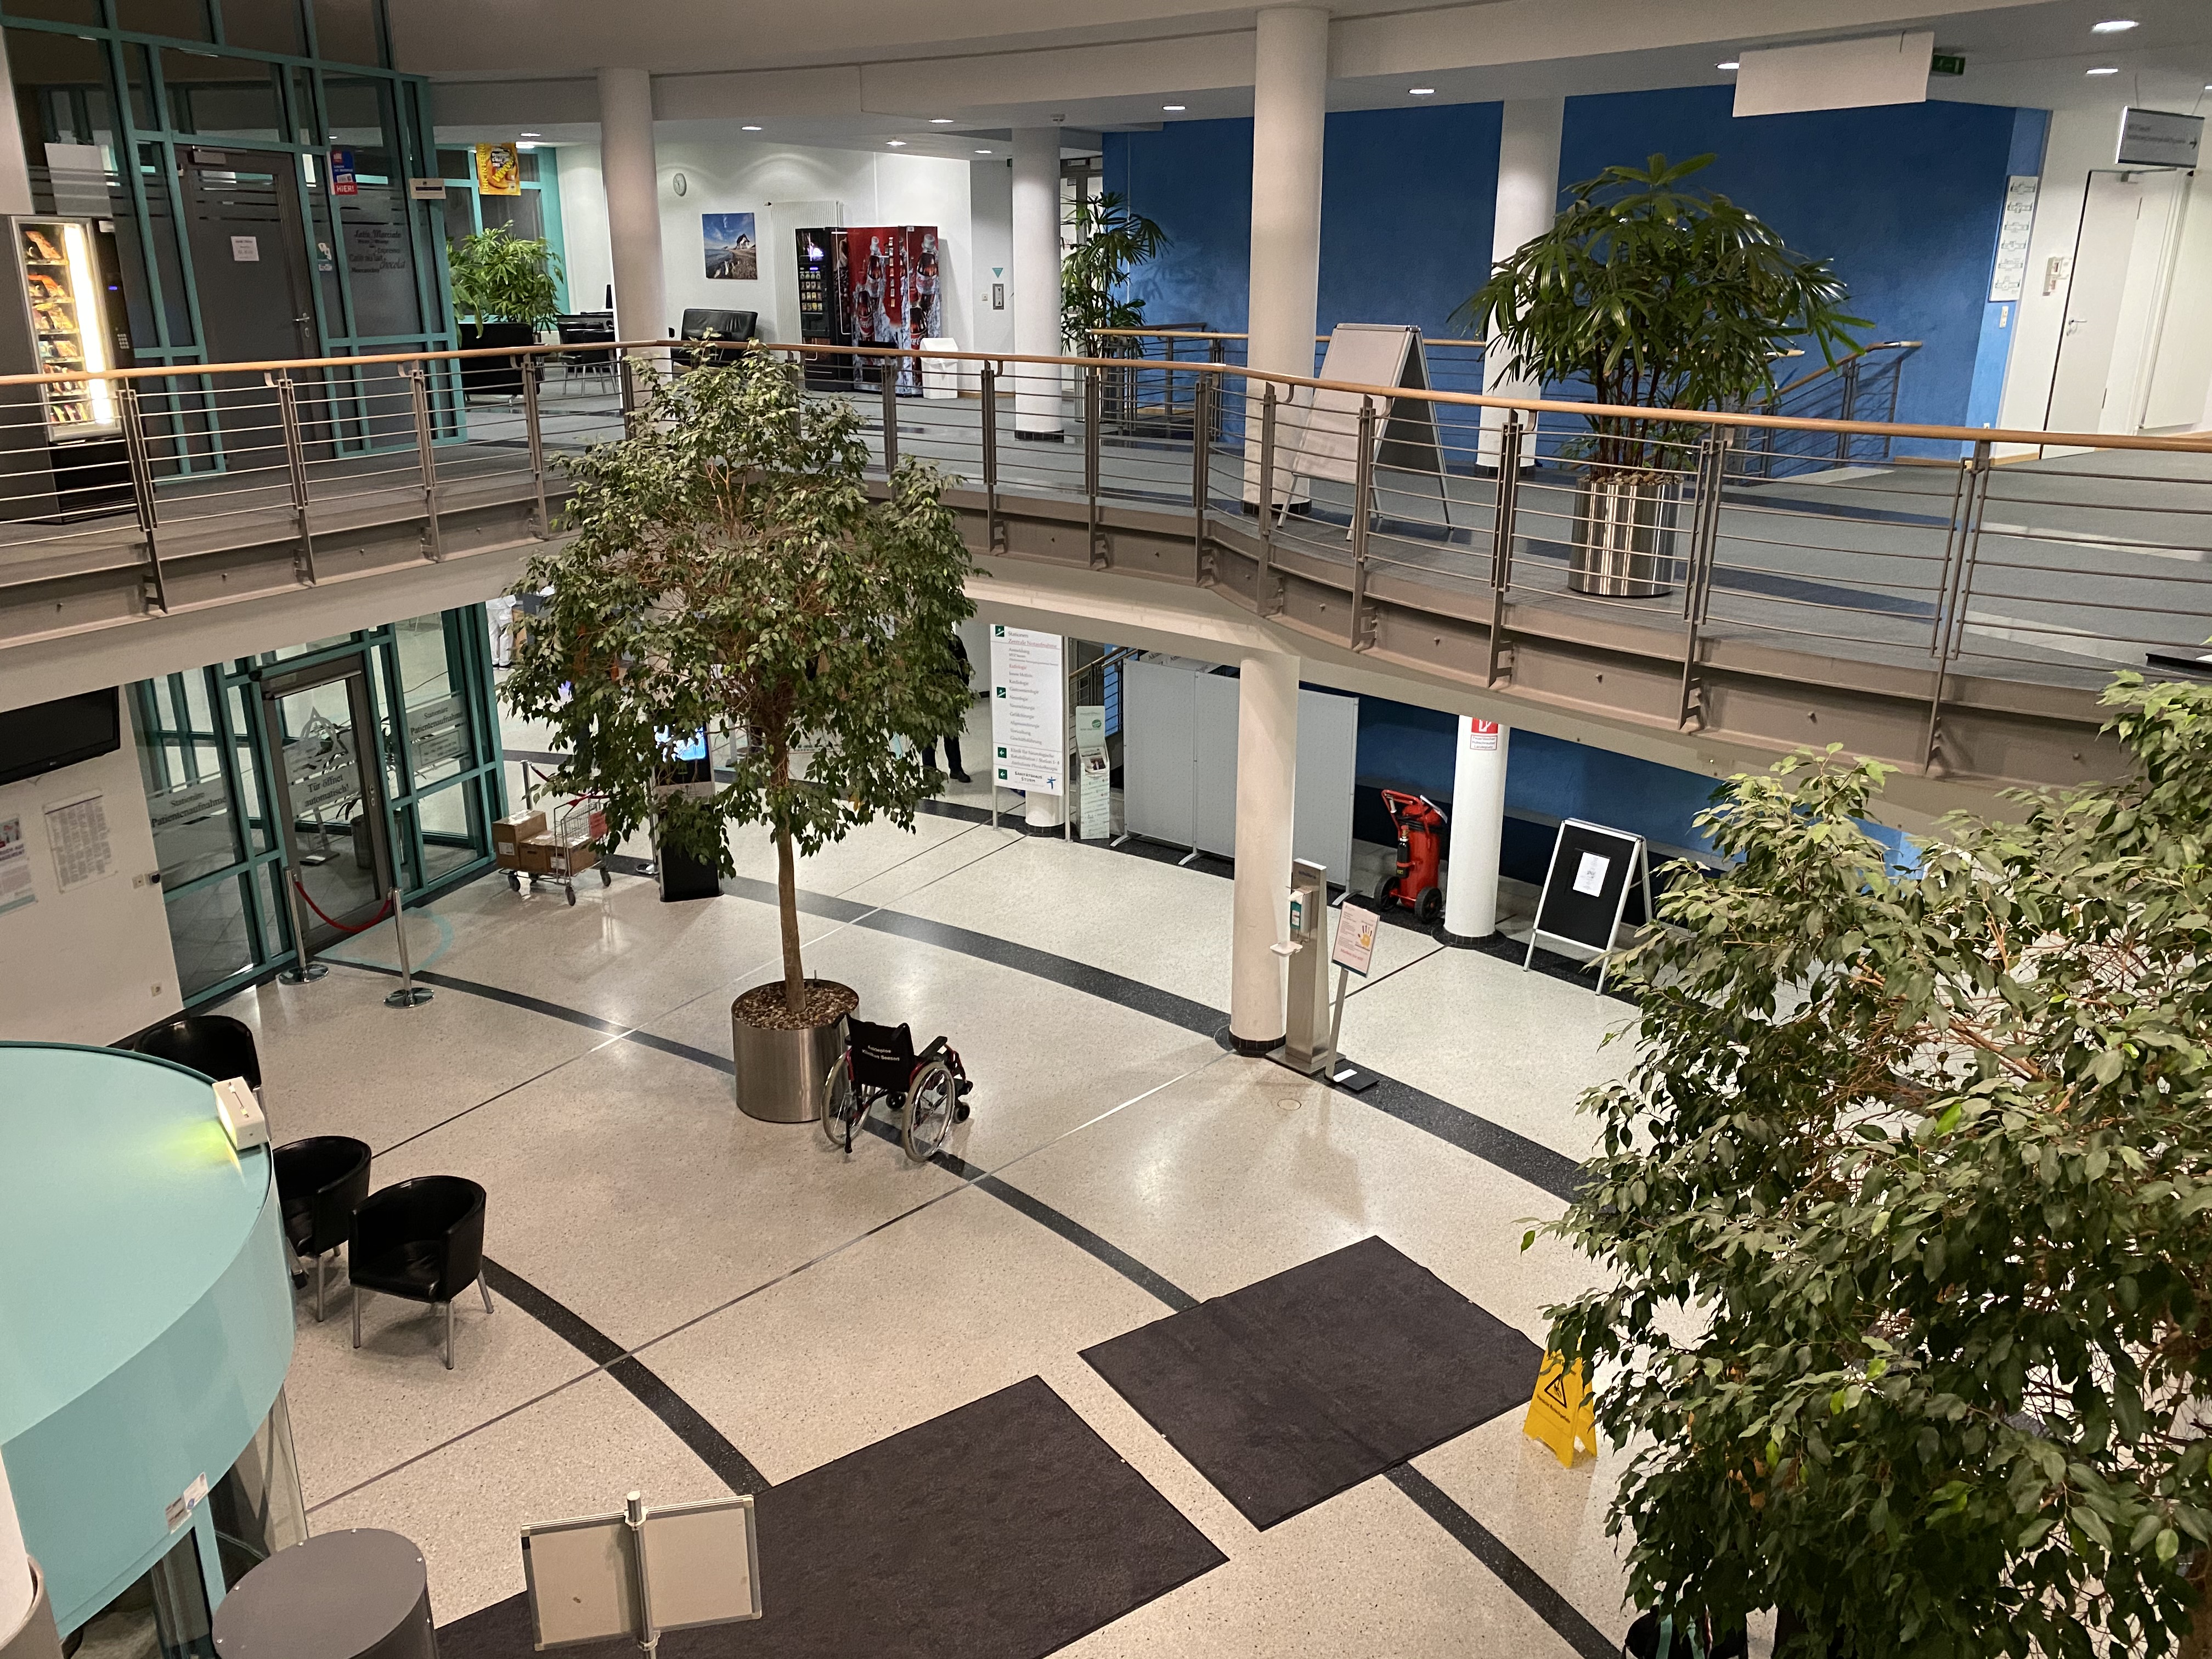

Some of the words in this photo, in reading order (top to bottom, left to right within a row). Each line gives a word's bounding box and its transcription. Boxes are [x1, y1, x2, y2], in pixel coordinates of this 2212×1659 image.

[424, 707, 448, 719] Stationäre
[410, 712, 464, 735] Patientenaufnahme
[308, 782, 320, 793] Tür
[323, 775, 343, 788] öffnet
[171, 792, 205, 808] Stationäre
[304, 783, 349, 807] automatisch!
[151, 795, 227, 828] Patientenaufnahme
